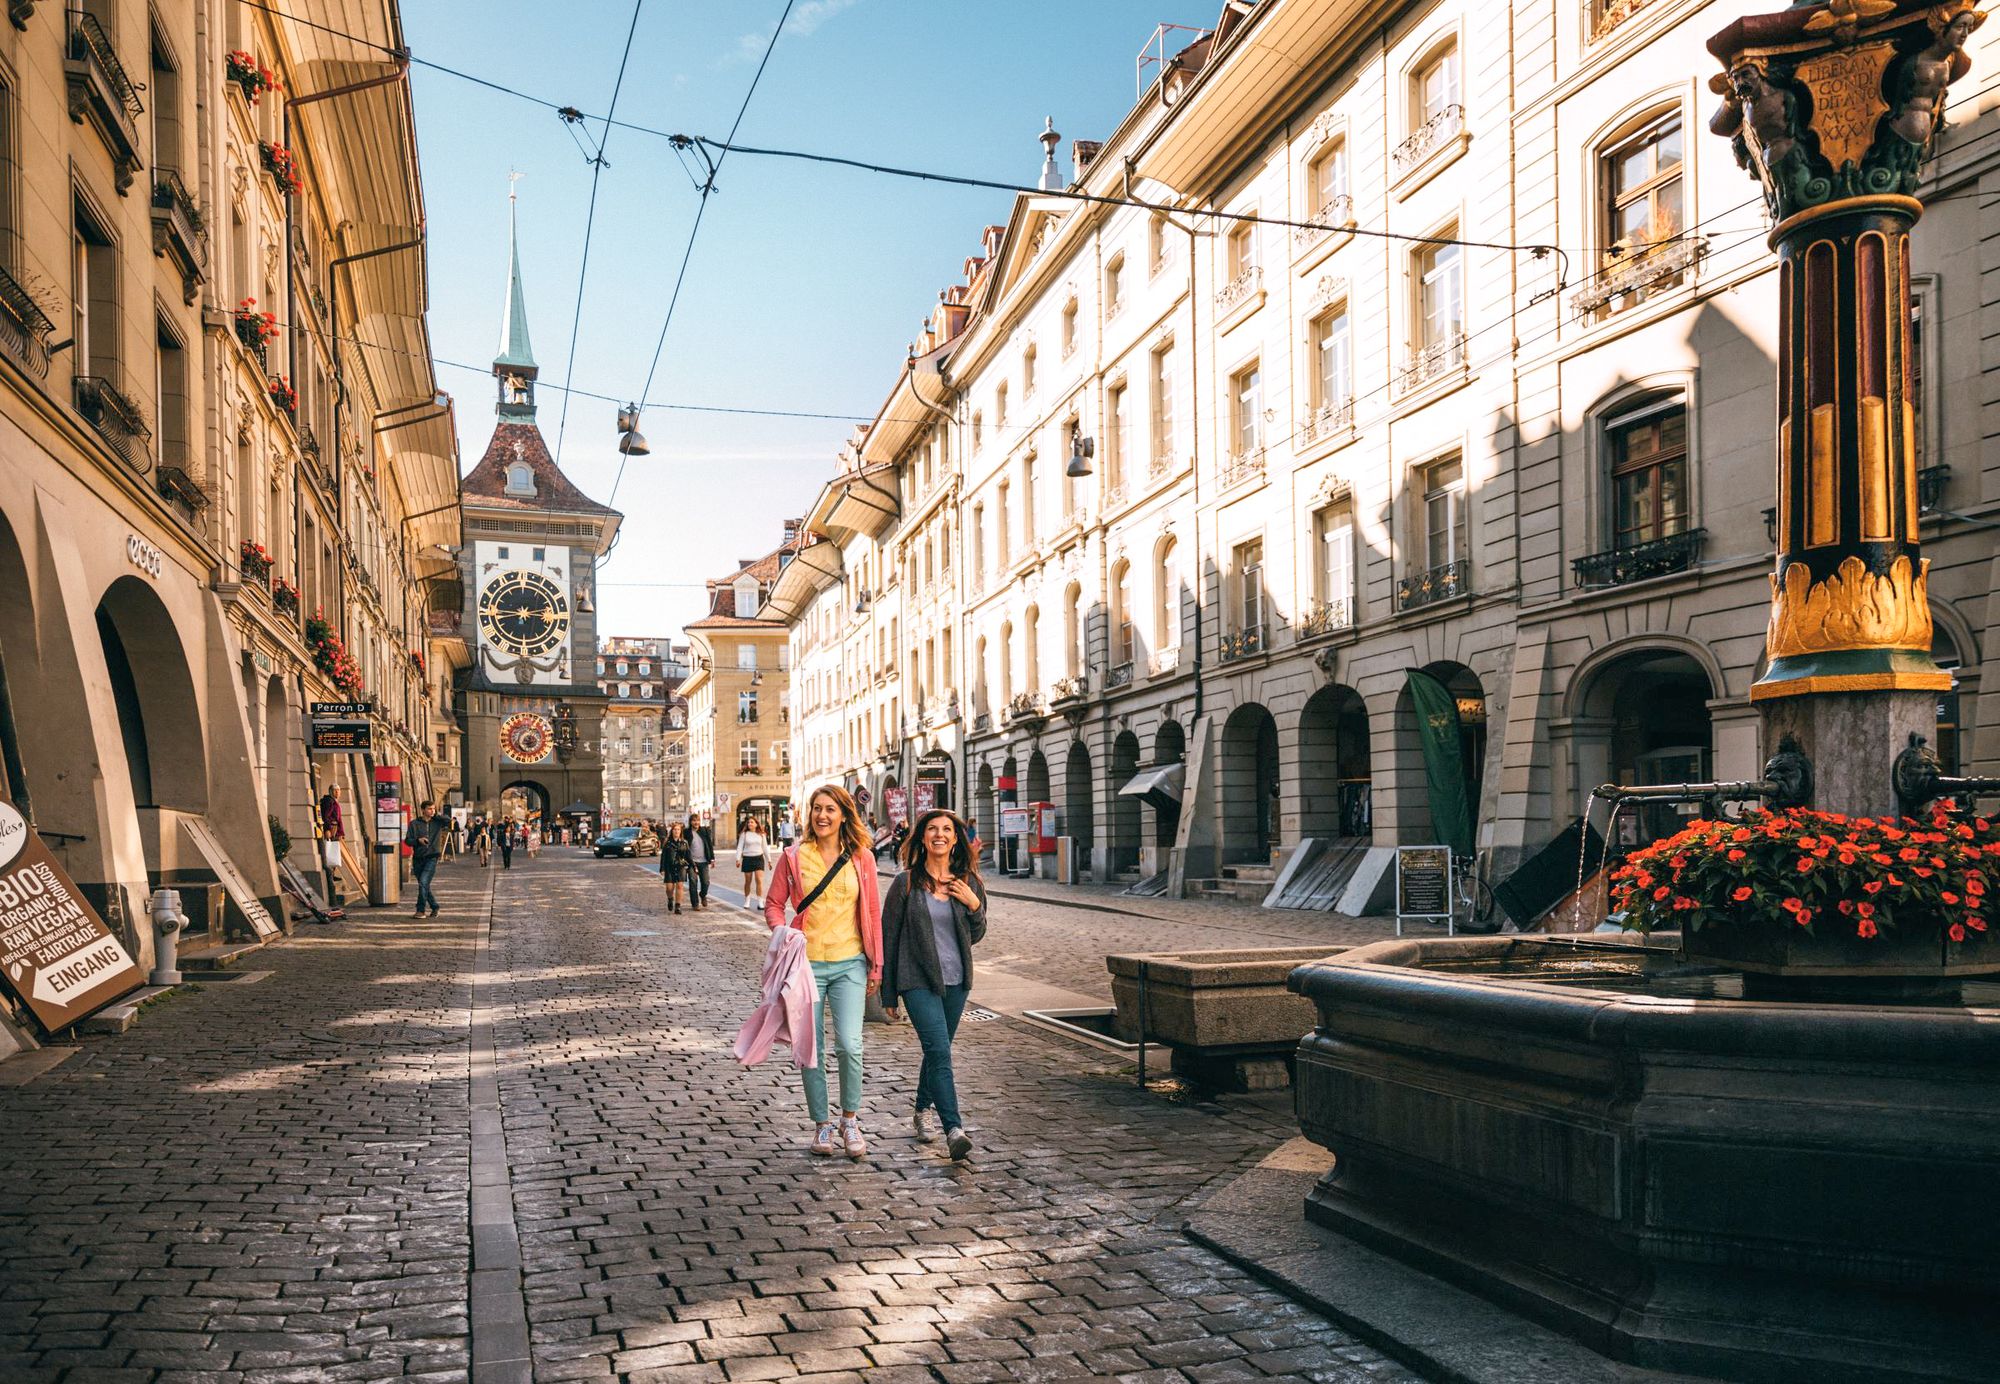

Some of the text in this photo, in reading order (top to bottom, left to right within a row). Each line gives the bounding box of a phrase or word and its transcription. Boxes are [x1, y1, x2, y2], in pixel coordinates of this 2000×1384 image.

[128, 535, 161, 579] ecco
[317, 704, 365, 712] Perron D
[0, 868, 44, 909] BIO
[31, 861, 72, 903] ROHKOST
[0, 894, 56, 929] ORGANIC
[26, 899, 84, 936] VEGAN
[1, 915, 90, 966] ABFALLFREI EINKAUFEN BIO
[3, 927, 34, 951] RAW
[36, 923, 101, 964] FAIRTRADE
[47, 945, 120, 993] EINGANG
